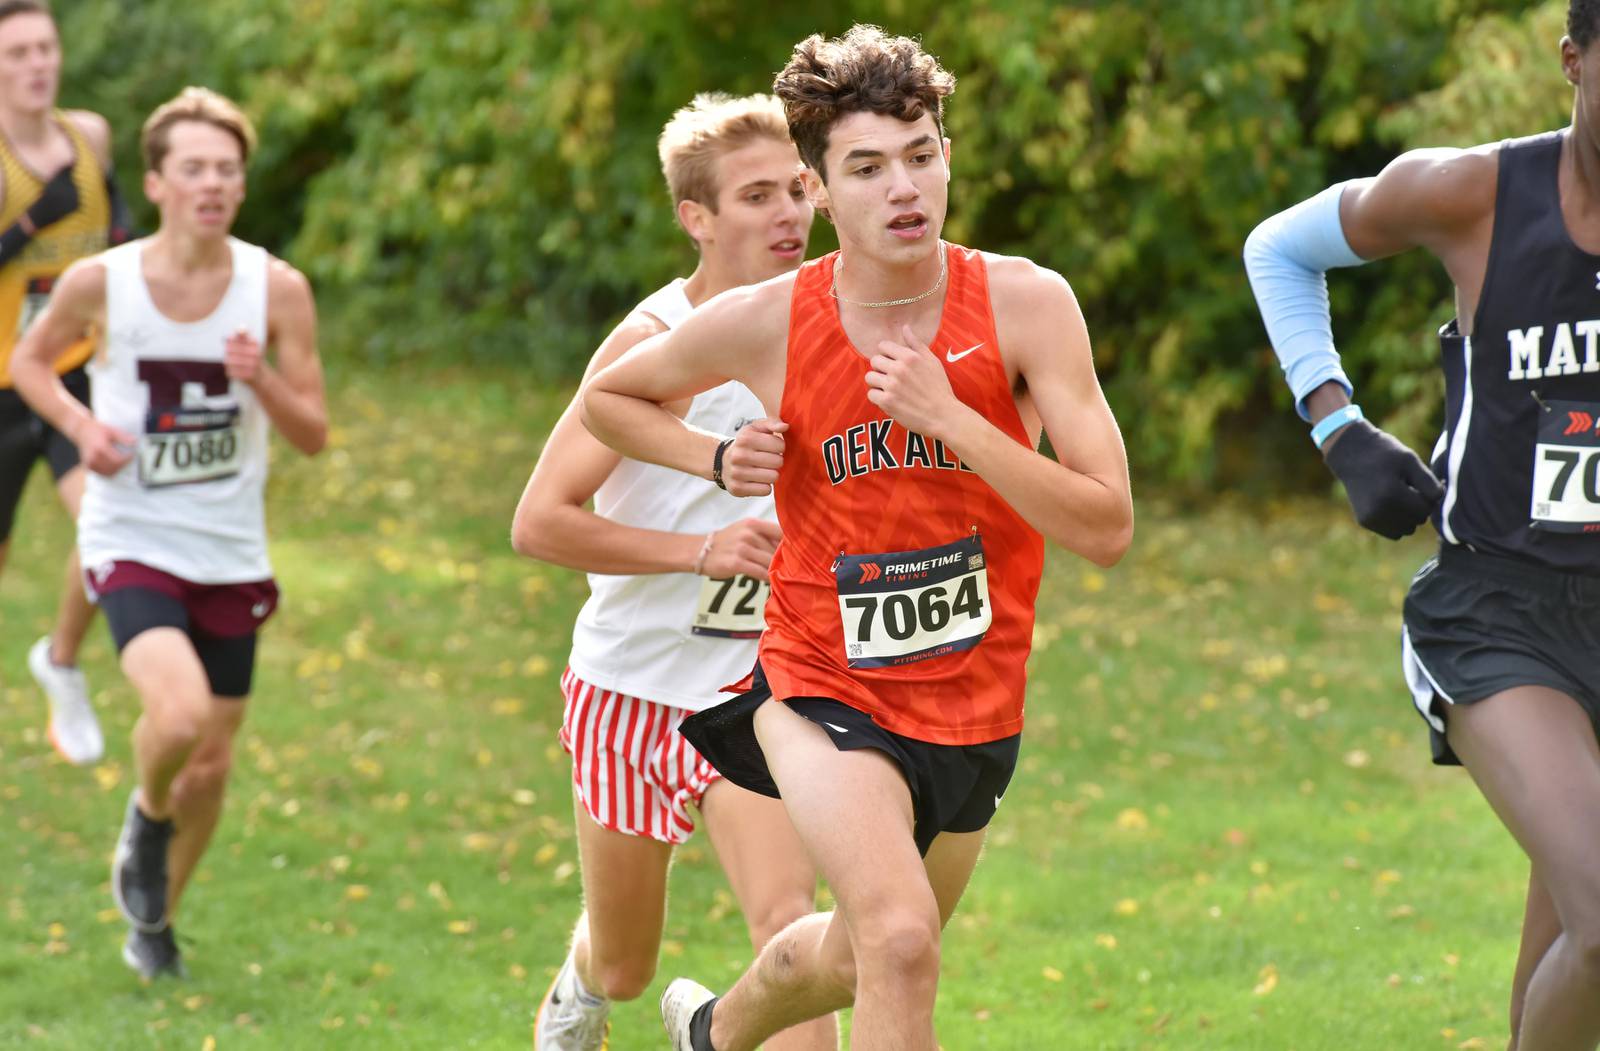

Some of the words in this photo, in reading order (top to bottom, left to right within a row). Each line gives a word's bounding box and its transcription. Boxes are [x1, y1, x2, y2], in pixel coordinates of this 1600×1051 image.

[148, 428, 236, 469] 7080
[822, 419, 976, 486] DEKAL
[885, 551, 963, 576] PRIMETIME
[886, 571, 928, 583] TIMING
[708, 573, 771, 615] 72
[845, 575, 984, 642] 7064
[894, 645, 953, 665] PTTIMING.COM
